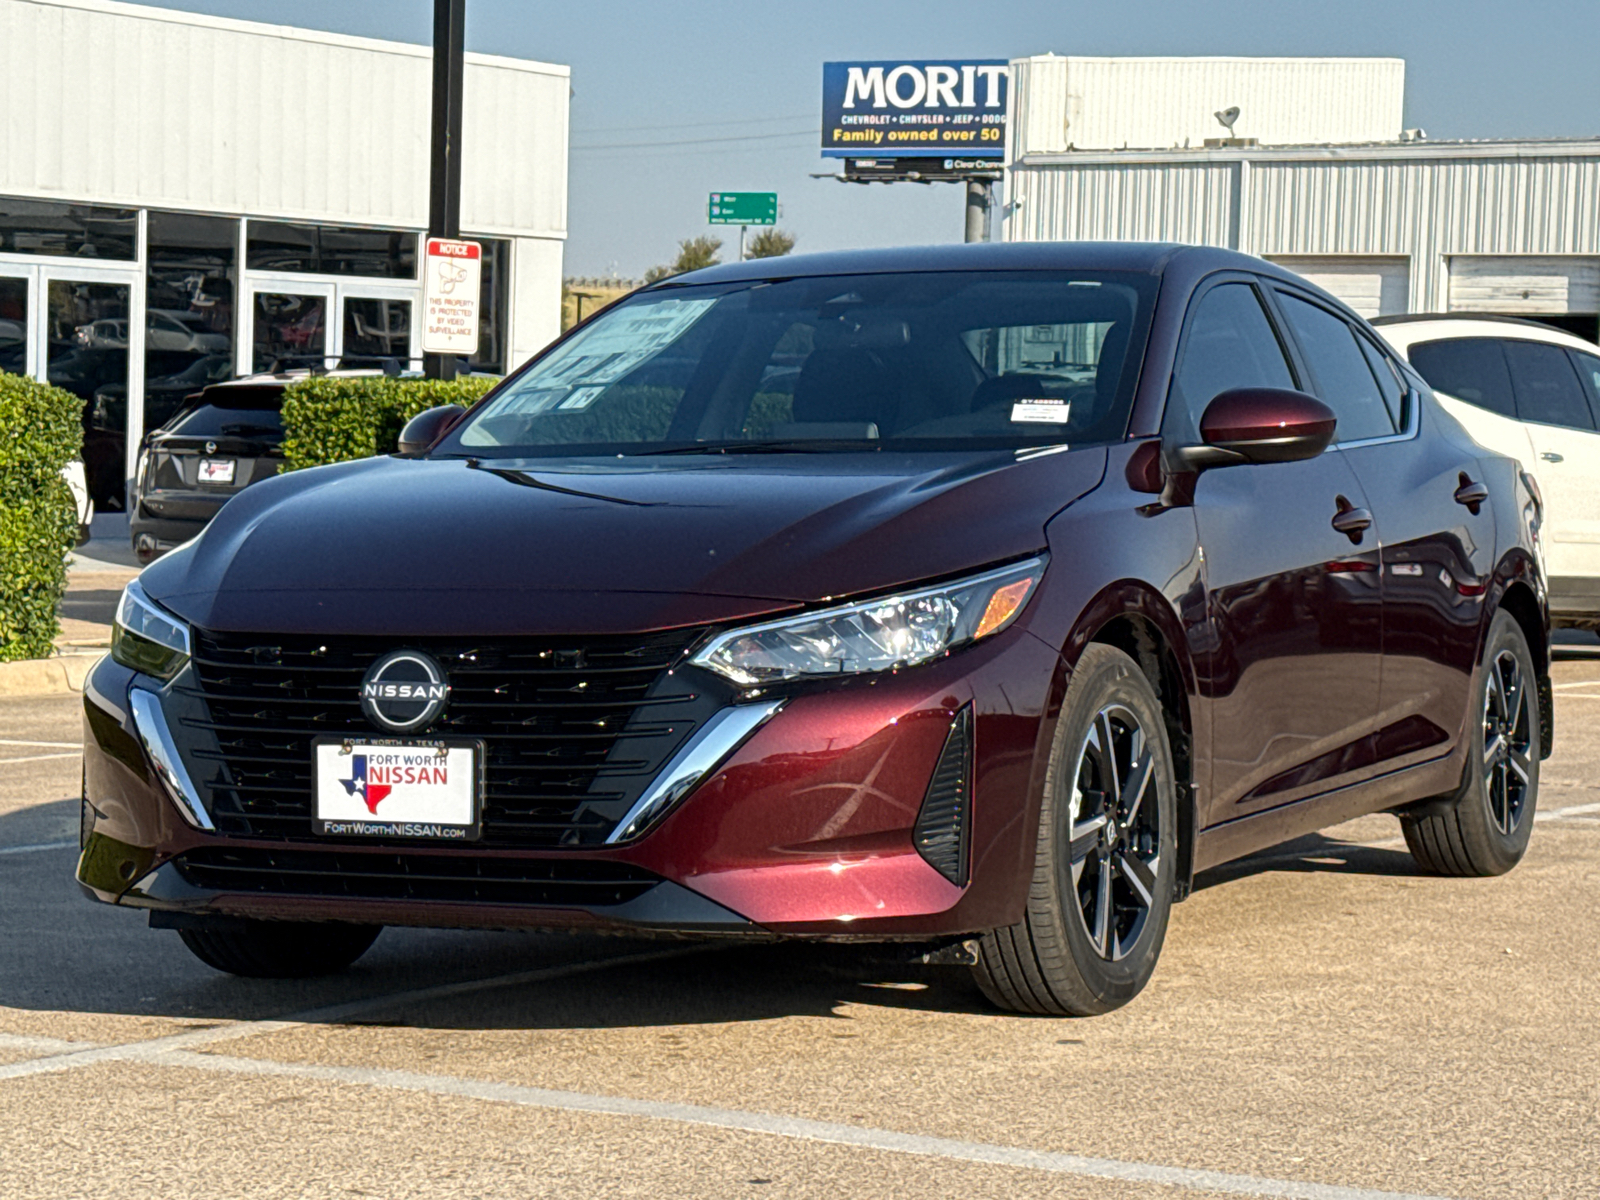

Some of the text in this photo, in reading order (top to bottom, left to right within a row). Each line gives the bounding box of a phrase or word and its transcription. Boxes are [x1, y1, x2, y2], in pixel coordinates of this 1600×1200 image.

[842, 65, 1008, 108] MORIT
[841, 114, 890, 124] CHEVROLET
[899, 114, 944, 124] CHRYSLER
[952, 114, 973, 124] JEEP
[833, 128, 1000, 144] Family owned over 50
[439, 244, 468, 255] NOTICE
[429, 297, 474, 307] THIS PROPERTY
[438, 308, 472, 317] PROTECTED
[447, 318, 465, 326] VIDEO
[429, 326, 472, 336] SURVEILLANCE
[365, 684, 443, 698] NISSAN
[370, 739, 402, 747] WORTH
[369, 754, 447, 766] FORT WORTH
[369, 766, 447, 785] NISSAN
